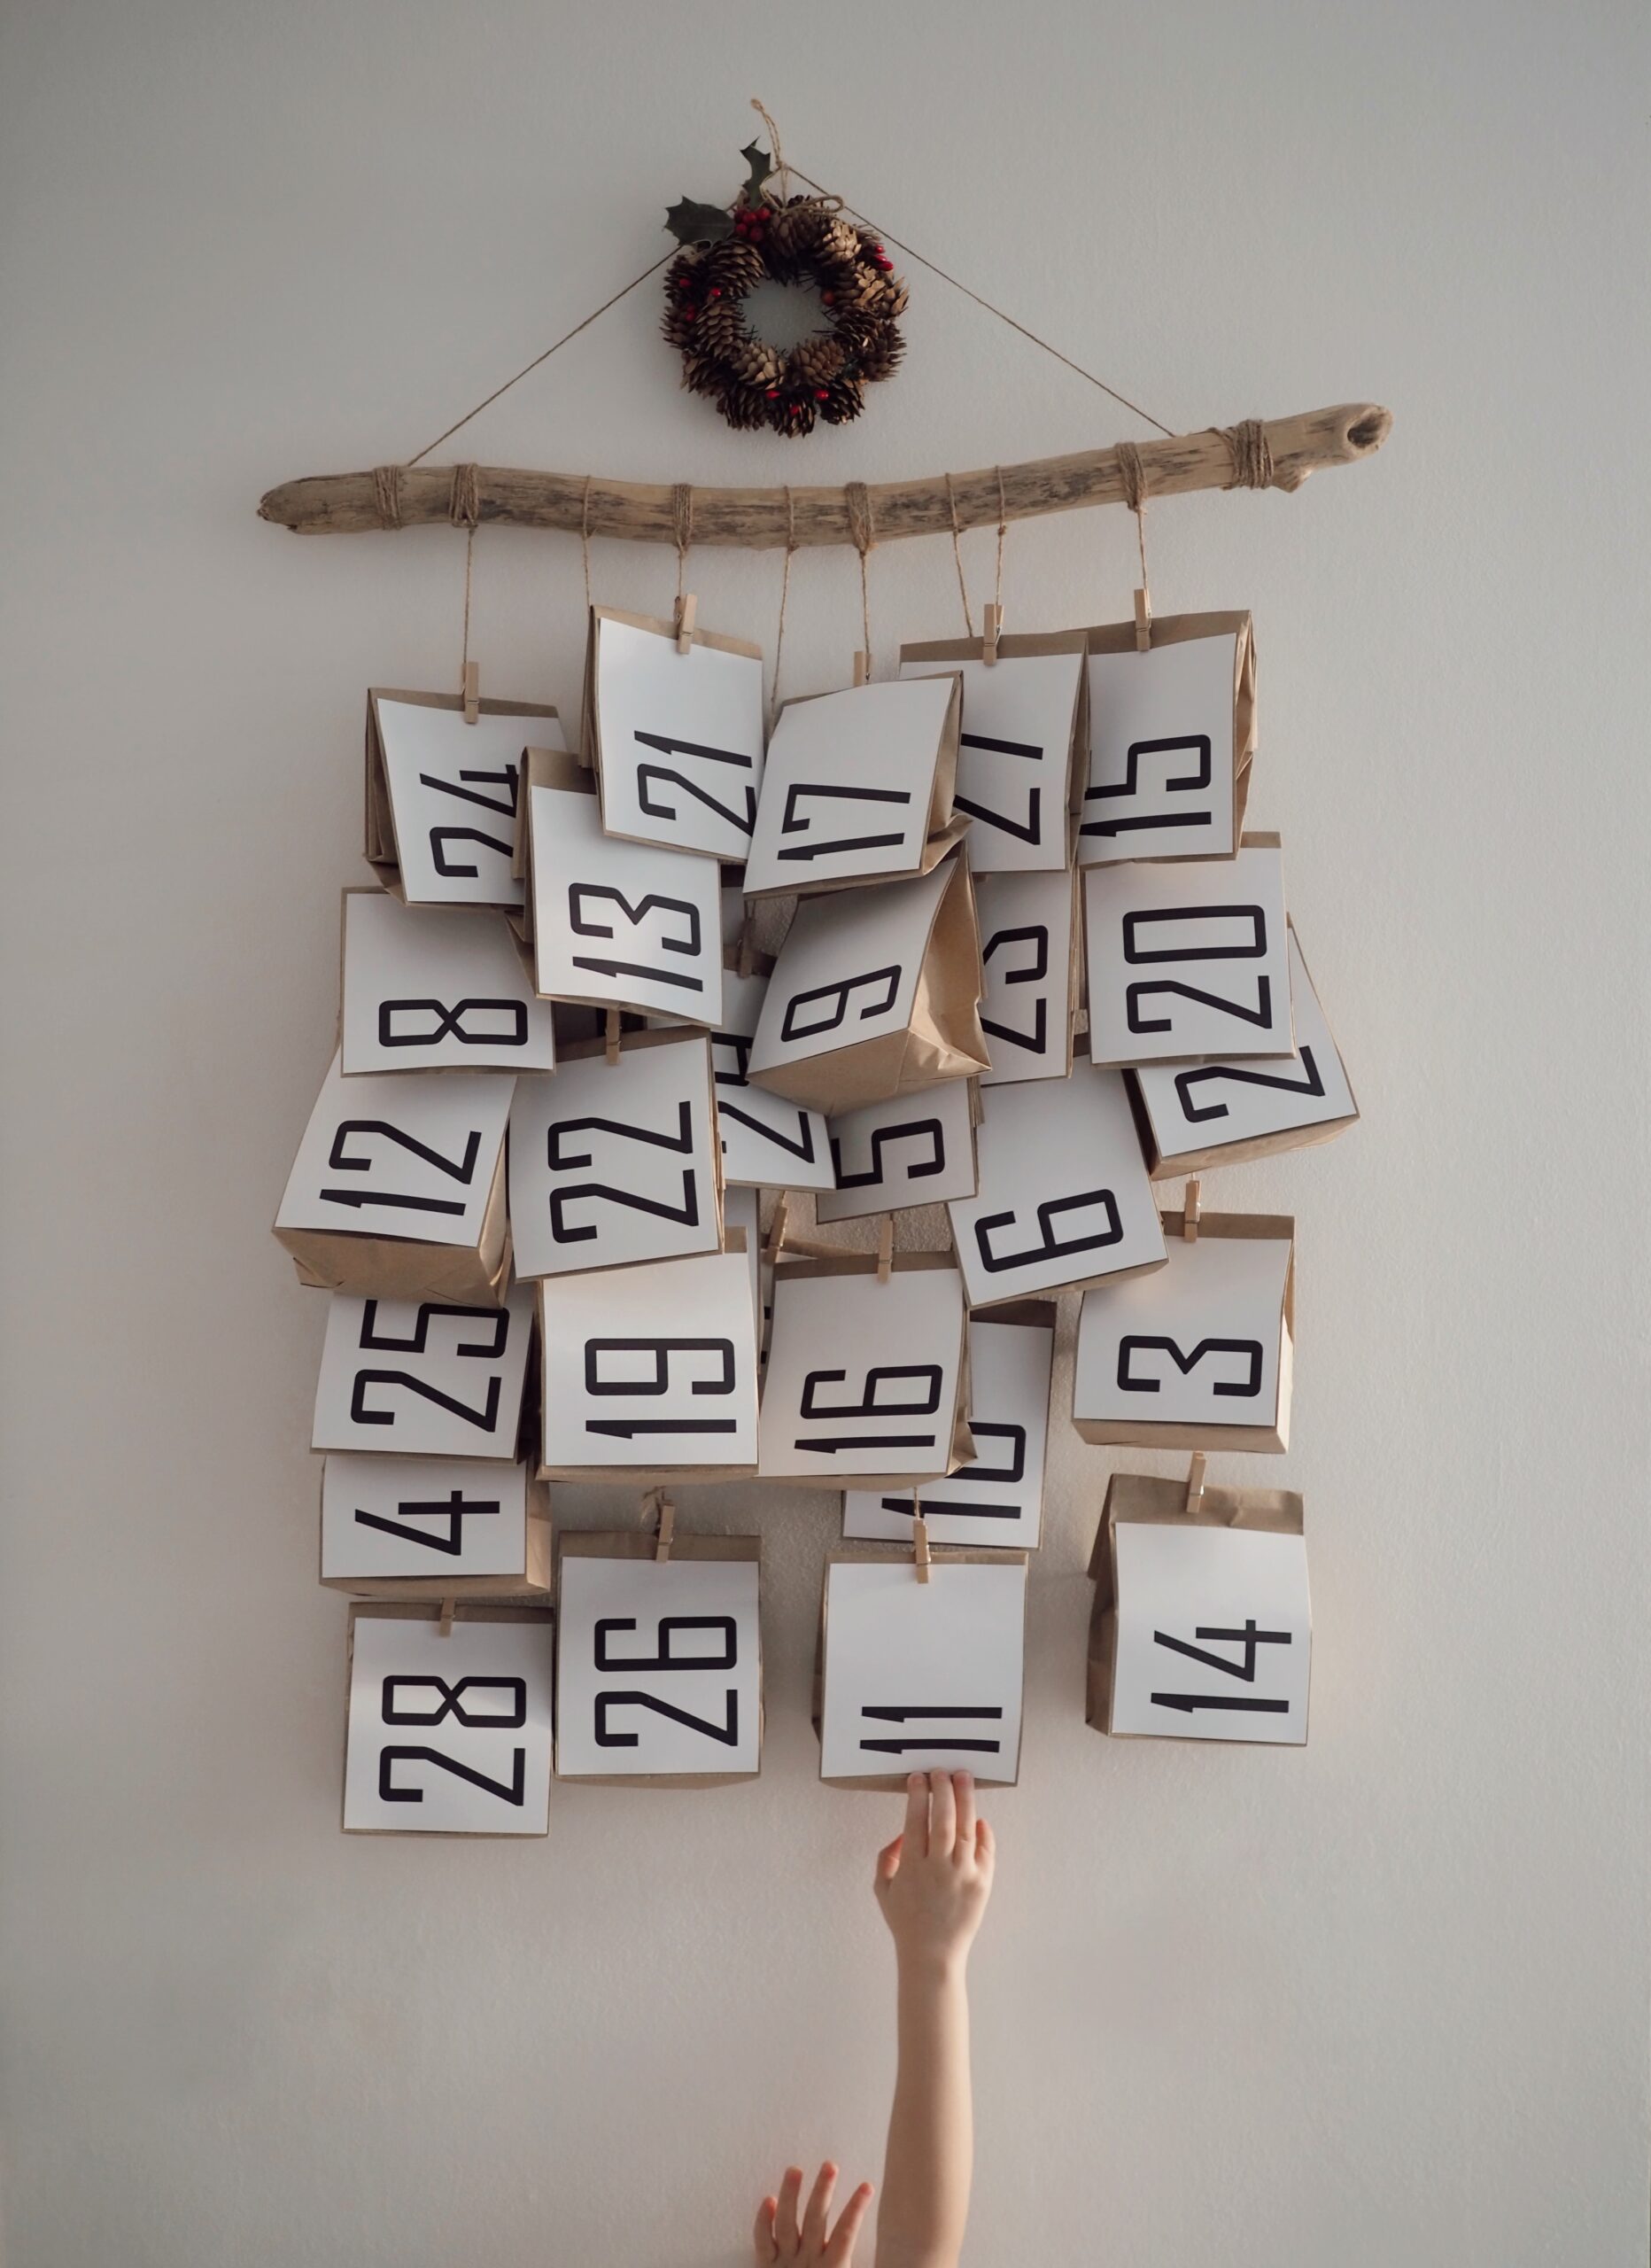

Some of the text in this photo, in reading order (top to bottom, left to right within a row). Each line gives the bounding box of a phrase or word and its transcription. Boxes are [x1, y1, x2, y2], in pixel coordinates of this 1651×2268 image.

[634, 730, 756, 838] 21
[777, 783, 911, 861] 17
[1078, 734, 1212, 838] 15
[568, 882, 703, 992] 13
[1122, 905, 1273, 1034] 20
[378, 998, 529, 1047] 8
[780, 965, 902, 1043] 9
[1174, 1045, 1326, 1123] 2
[319, 1120, 482, 1216] 12
[547, 1100, 699, 1244] 22
[831, 1118, 946, 1191] 5
[974, 1189, 1124, 1273] 6
[350, 1299, 510, 1433] 25
[585, 1338, 737, 1440] 19
[794, 1364, 943, 1454] 16
[1117, 1335, 1263, 1397] 3
[354, 1490, 500, 1557] 4
[594, 1616, 738, 1748] 26
[1151, 1619, 1291, 1713] 14
[378, 1674, 527, 1807] 28
[859, 1706, 1003, 1755] 11
